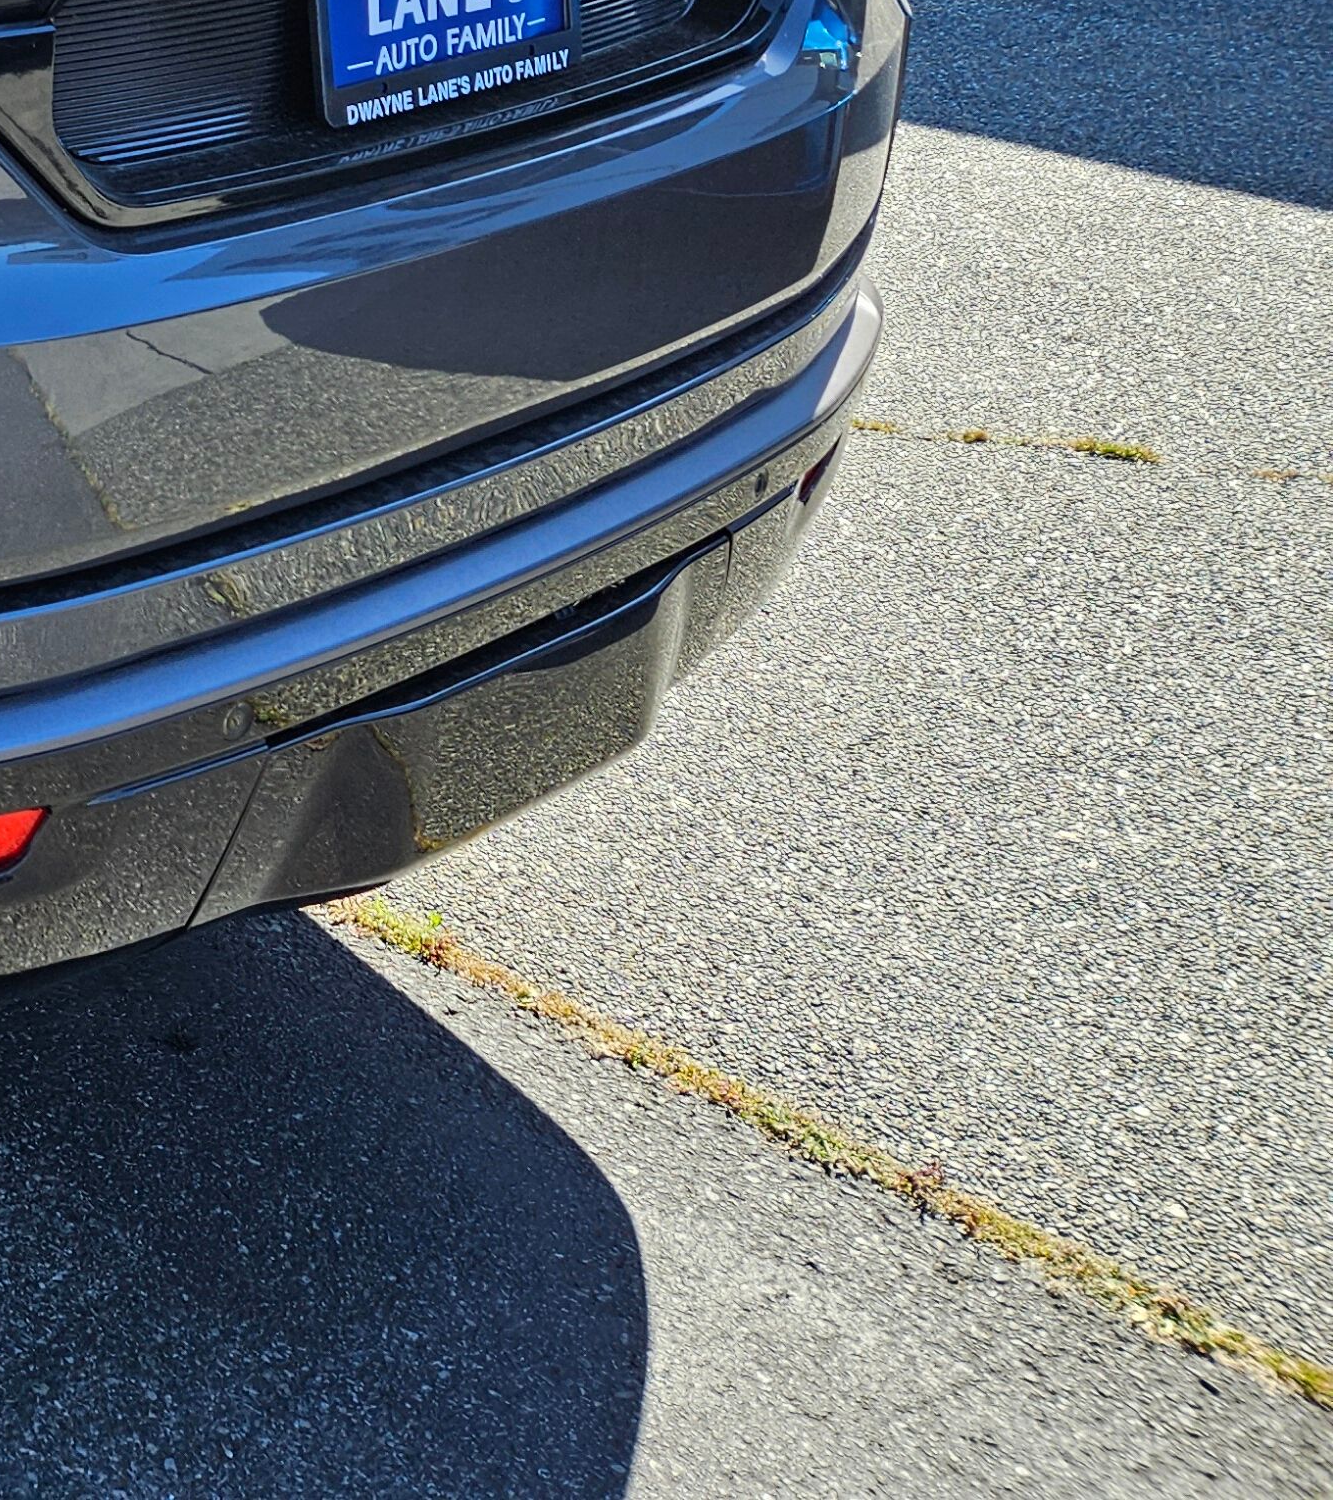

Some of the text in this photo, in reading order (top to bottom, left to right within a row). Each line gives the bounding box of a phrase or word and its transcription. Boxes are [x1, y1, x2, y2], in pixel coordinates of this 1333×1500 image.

[375, 12, 527, 76] AUTO FAMILY
[346, 48, 570, 126] DWAYNE LANE'S AUTO FAMILY
